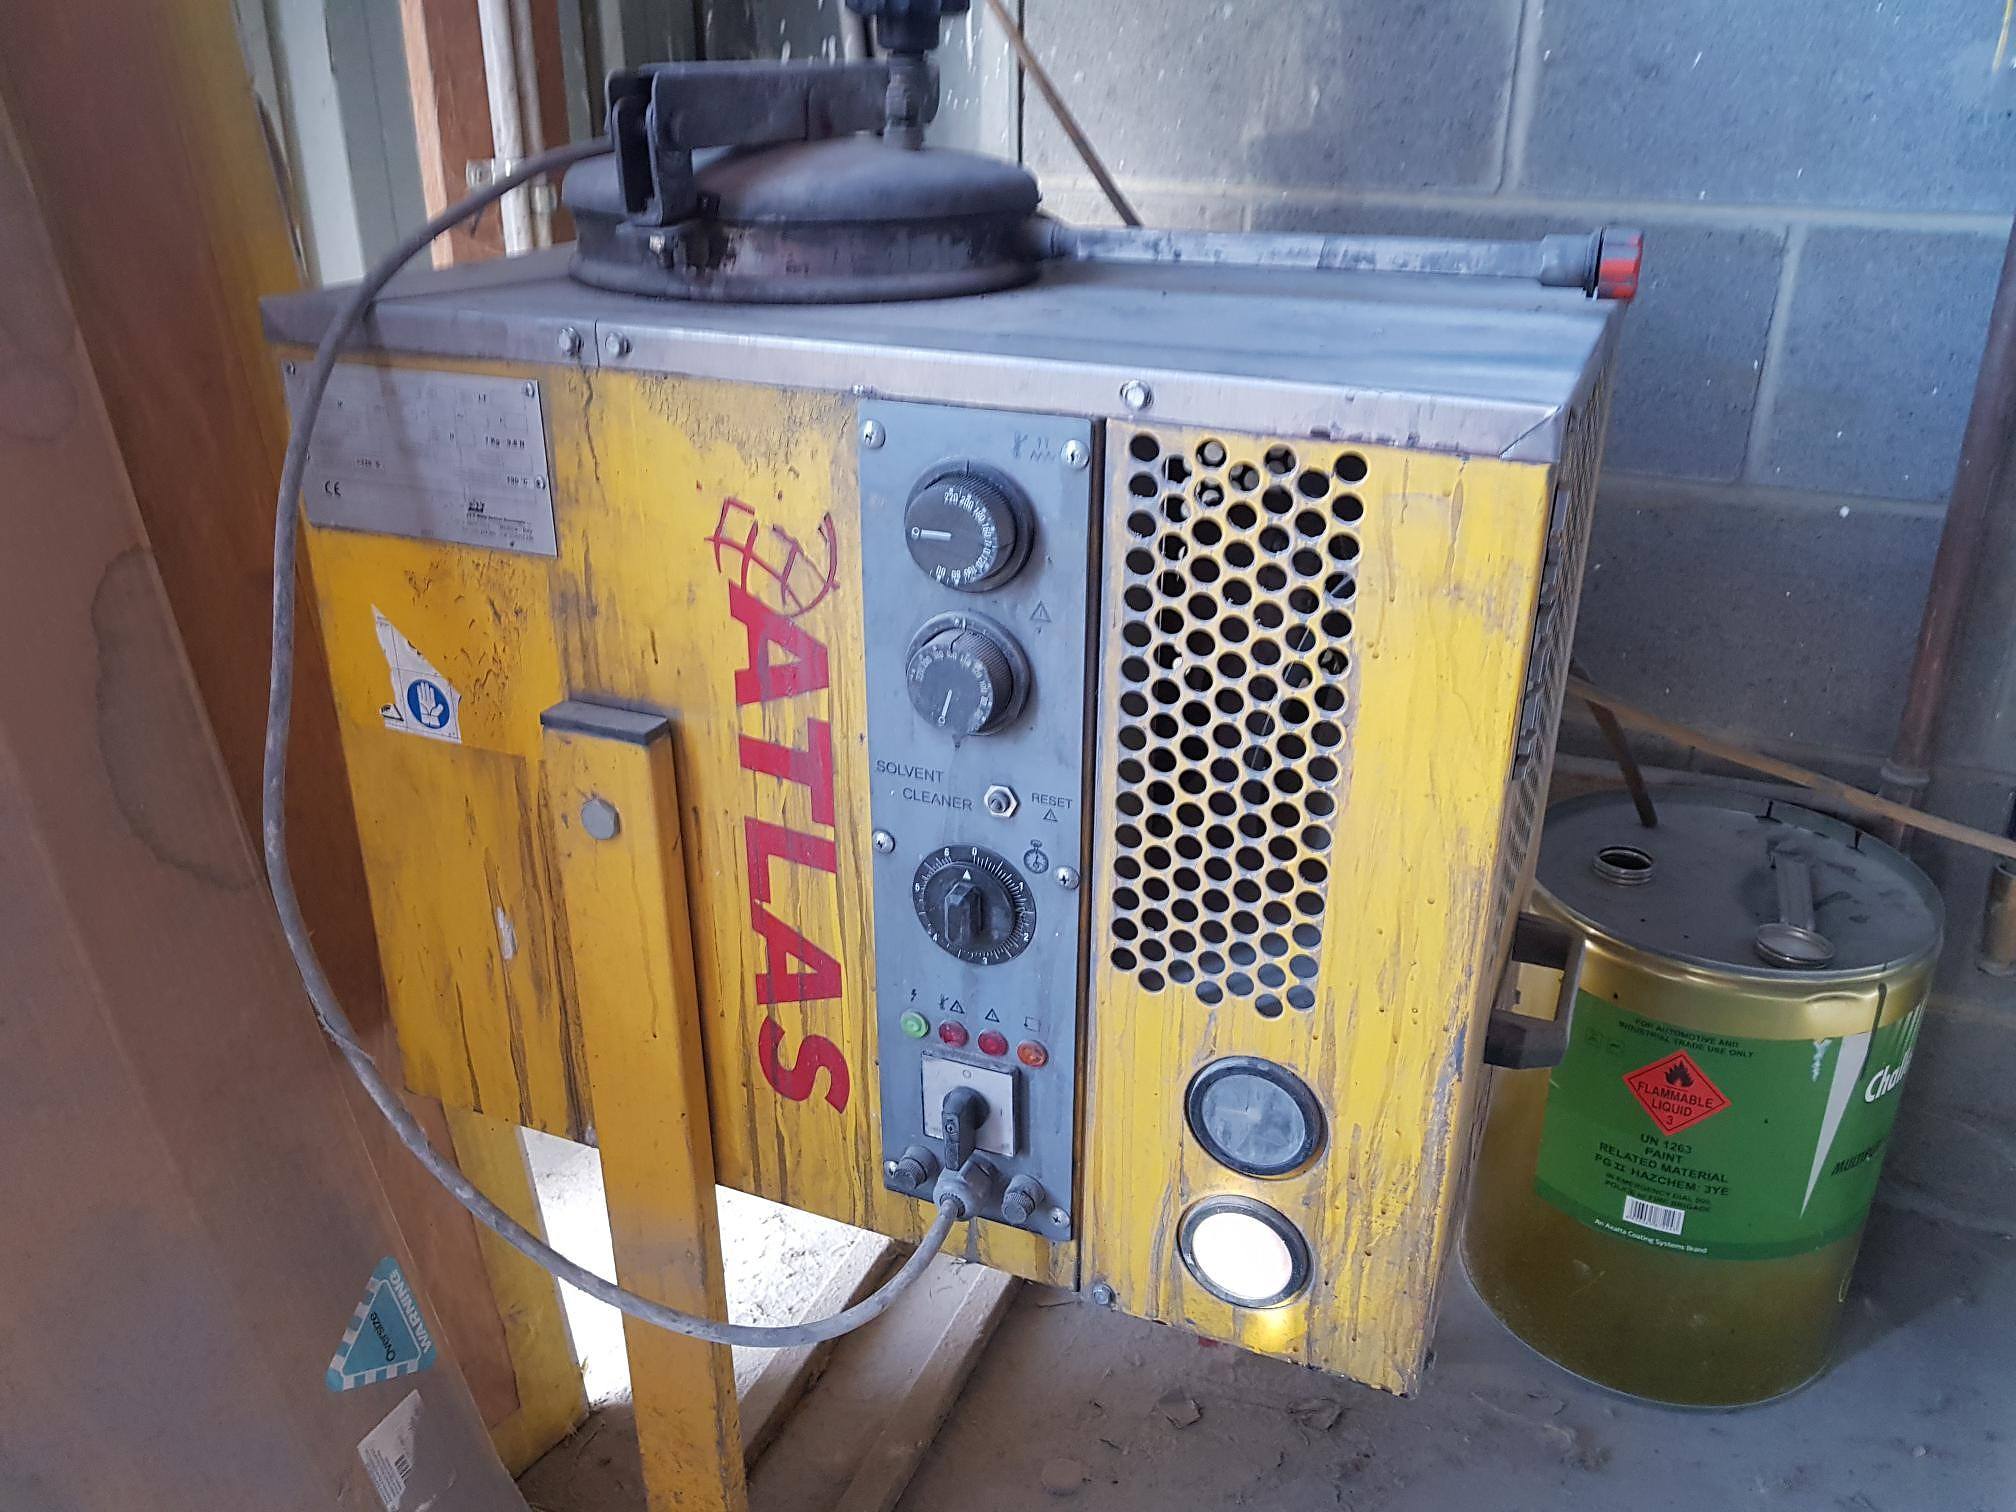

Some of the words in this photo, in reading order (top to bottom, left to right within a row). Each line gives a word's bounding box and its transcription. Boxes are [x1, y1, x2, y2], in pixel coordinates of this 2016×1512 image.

[876, 759, 944, 783] SOLVENT
[902, 787, 974, 812] CLEANER
[1031, 792, 1073, 809] RESET
[729, 578, 851, 1116] ATLAS
[1618, 1020, 1670, 1043] INDUSTRIAL
[1673, 1038, 1704, 1051] TRADE
[1707, 1045, 1726, 1055] USE
[1728, 1048, 1755, 1059] ONLY
[1656, 1025, 1716, 1045] AUTOMOTIVE
[1718, 1038, 1739, 1048] AND
[1637, 1081, 1714, 1109] FLAMMABLE
[1651, 1097, 1693, 1117] LIQUID
[1665, 1115, 1674, 1126] 3
[1641, 1133, 1660, 1146] UN
[1664, 1140, 1693, 1155] 1263
[1645, 1146, 1682, 1164] PAINT
[1594, 1152, 1612, 1168] PG
[1631, 1167, 1697, 1192] HAZCHEM
[1599, 1141, 1658, 1169] RELATED
[1661, 1163, 1729, 1184] MATERIAL
[1594, 1218, 1604, 1227] An
[1628, 1230, 1656, 1246] Coating
[1656, 1239, 1686, 1252] Systems
[1686, 1244, 1709, 1254] Brand
[389, 1267, 433, 1354] WARNING
[370, 1311, 396, 1362] Oversize
